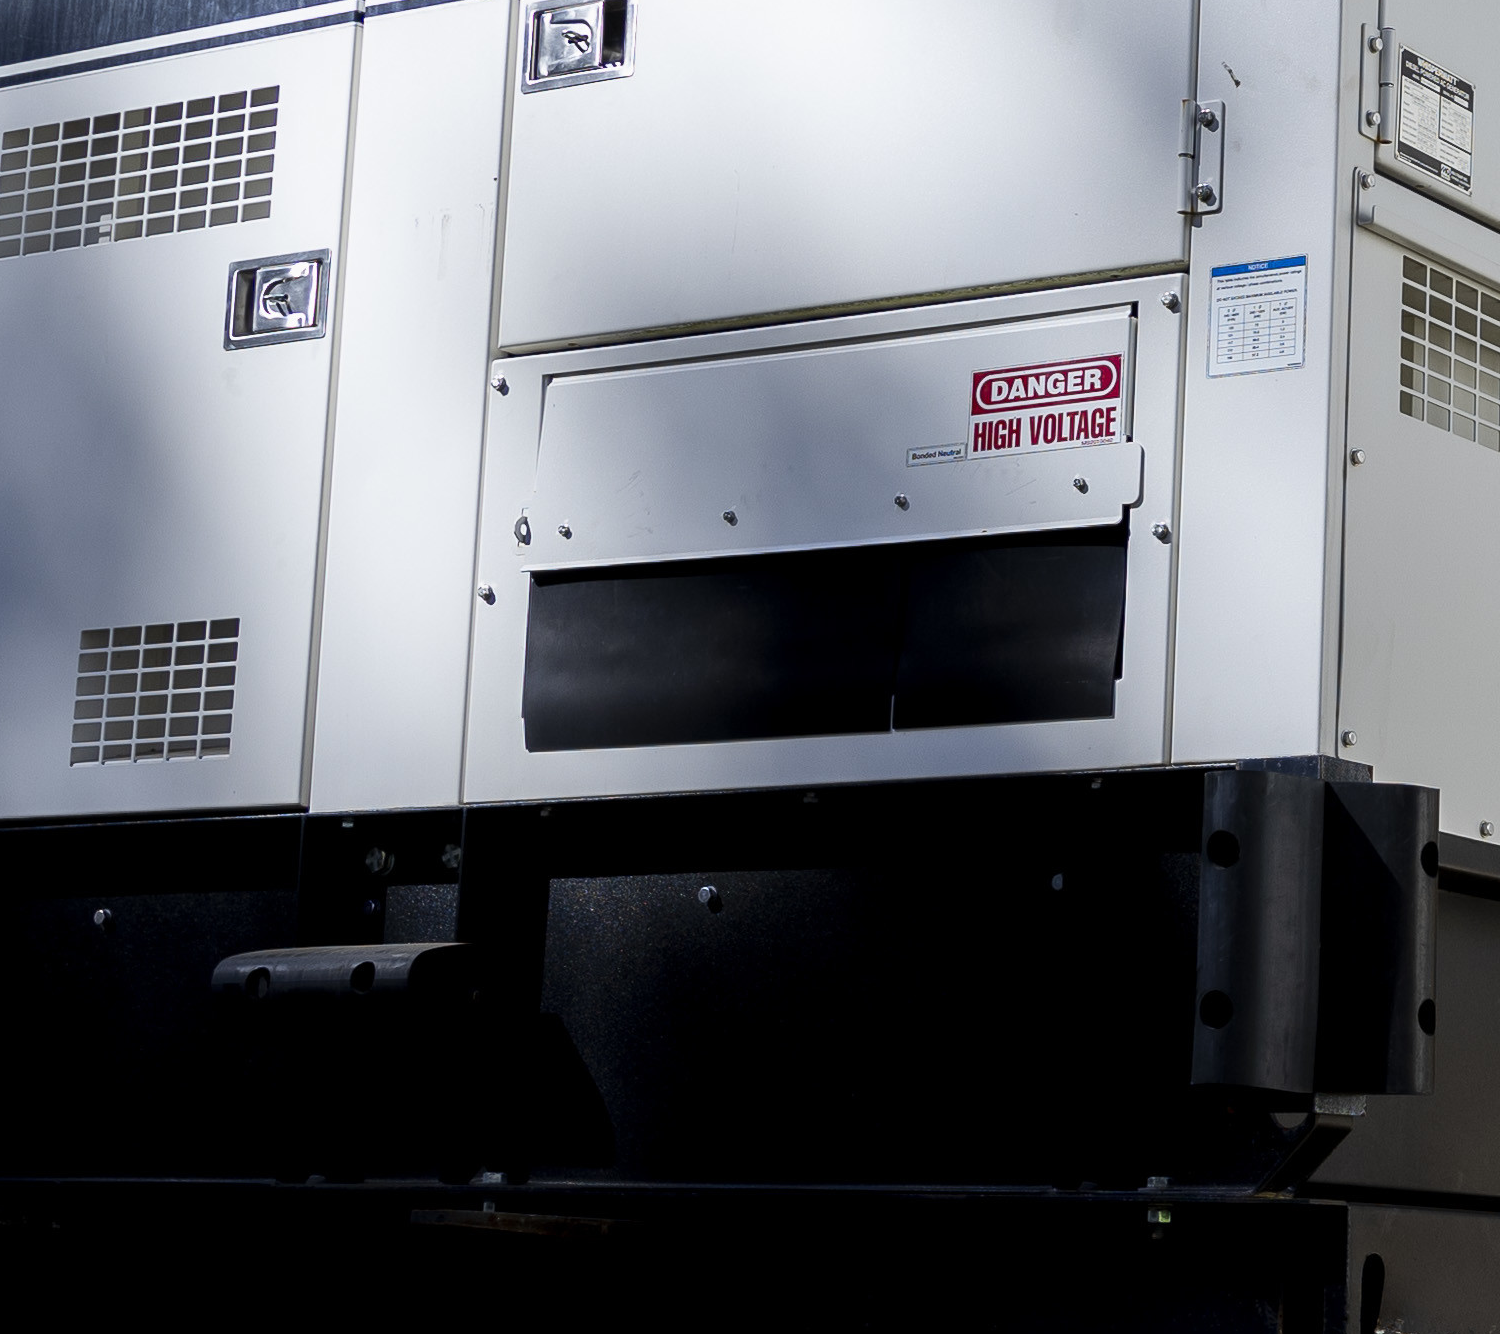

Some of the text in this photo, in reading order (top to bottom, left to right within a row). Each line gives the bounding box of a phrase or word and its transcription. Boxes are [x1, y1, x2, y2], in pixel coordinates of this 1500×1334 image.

[991, 368, 1102, 402] DANGER
[973, 406, 1117, 453] HIGH VOLTAGE
[912, 449, 961, 460] Bonded Neutral
